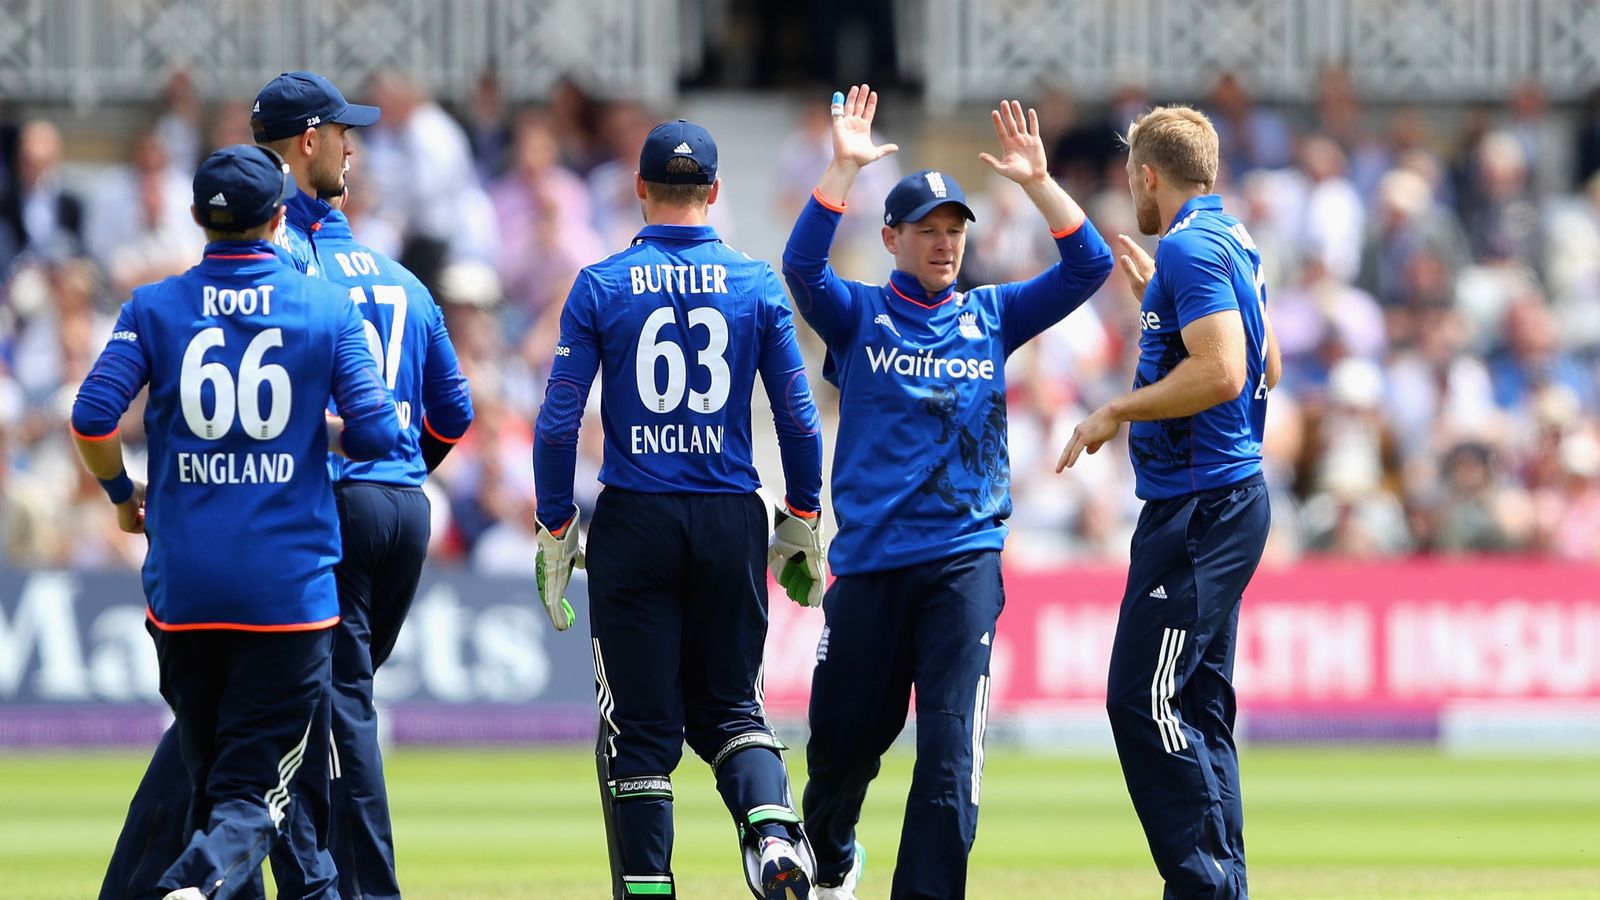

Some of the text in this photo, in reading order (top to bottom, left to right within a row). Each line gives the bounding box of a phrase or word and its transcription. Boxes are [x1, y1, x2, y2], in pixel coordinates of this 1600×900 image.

[306, 115, 321, 127] 236
[334, 251, 380, 278] ROY
[629, 264, 729, 296] BUTTLER
[202, 284, 275, 317] ROOT
[635, 306, 731, 414] 63
[865, 346, 995, 380] Waitrose
[179, 327, 292, 441] 66
[631, 424, 724, 454] ENGLAN
[178, 452, 295, 484] ENGLAND
